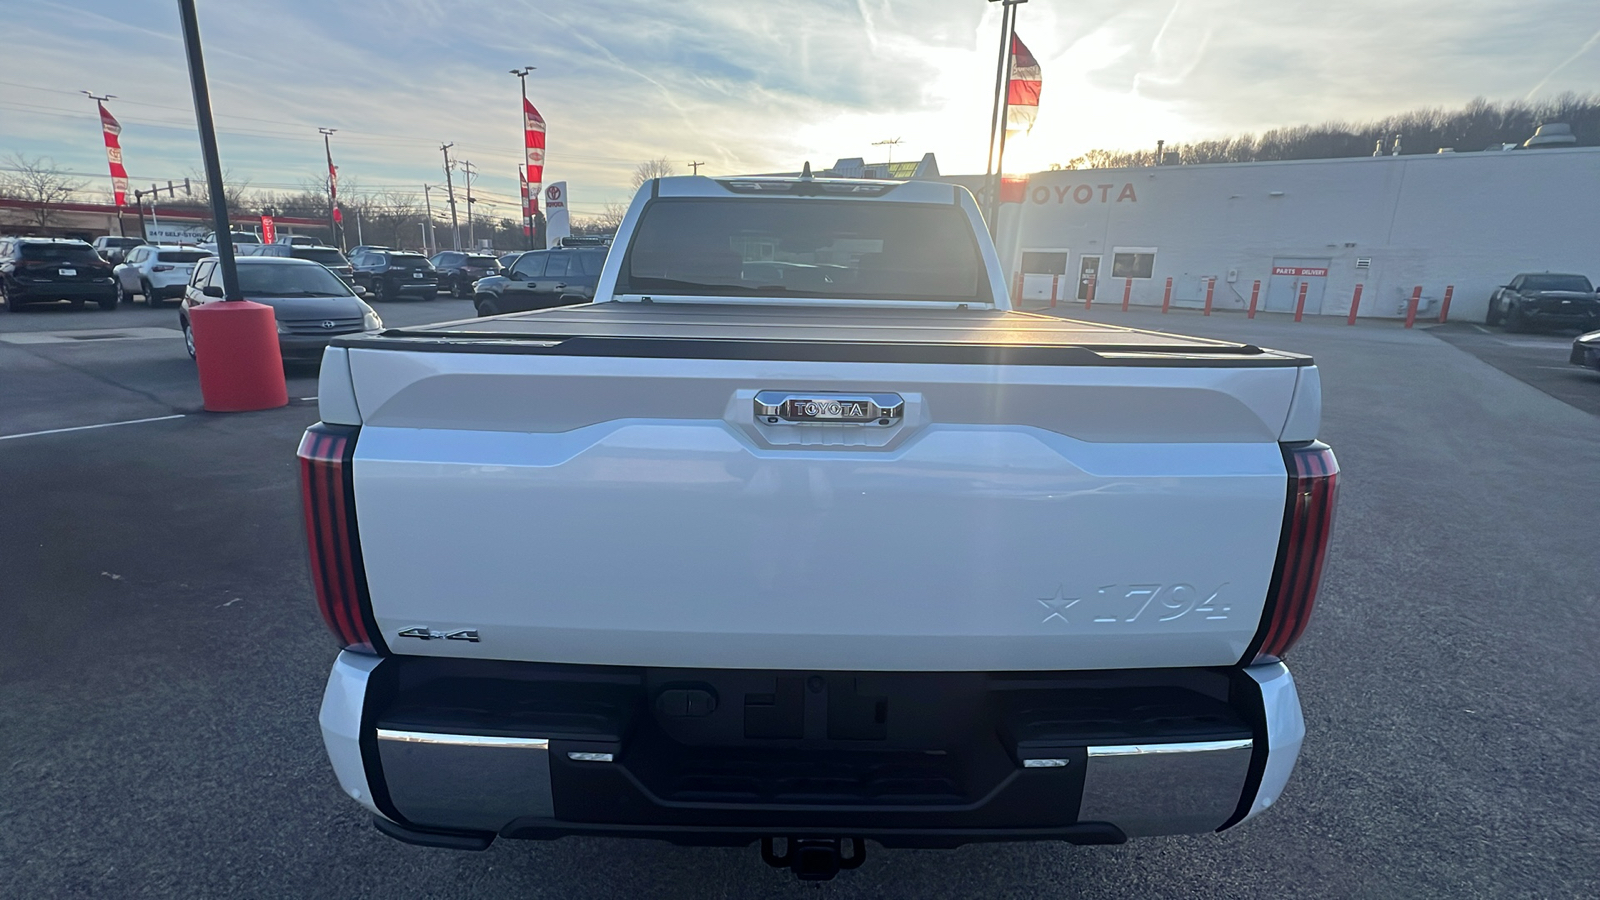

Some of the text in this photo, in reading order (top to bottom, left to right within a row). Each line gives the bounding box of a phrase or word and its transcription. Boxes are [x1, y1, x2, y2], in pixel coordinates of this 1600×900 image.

[1025, 183, 1137, 205] OYOTA
[795, 401, 863, 417] TOYOTA
[1093, 582, 1231, 622] 1794
